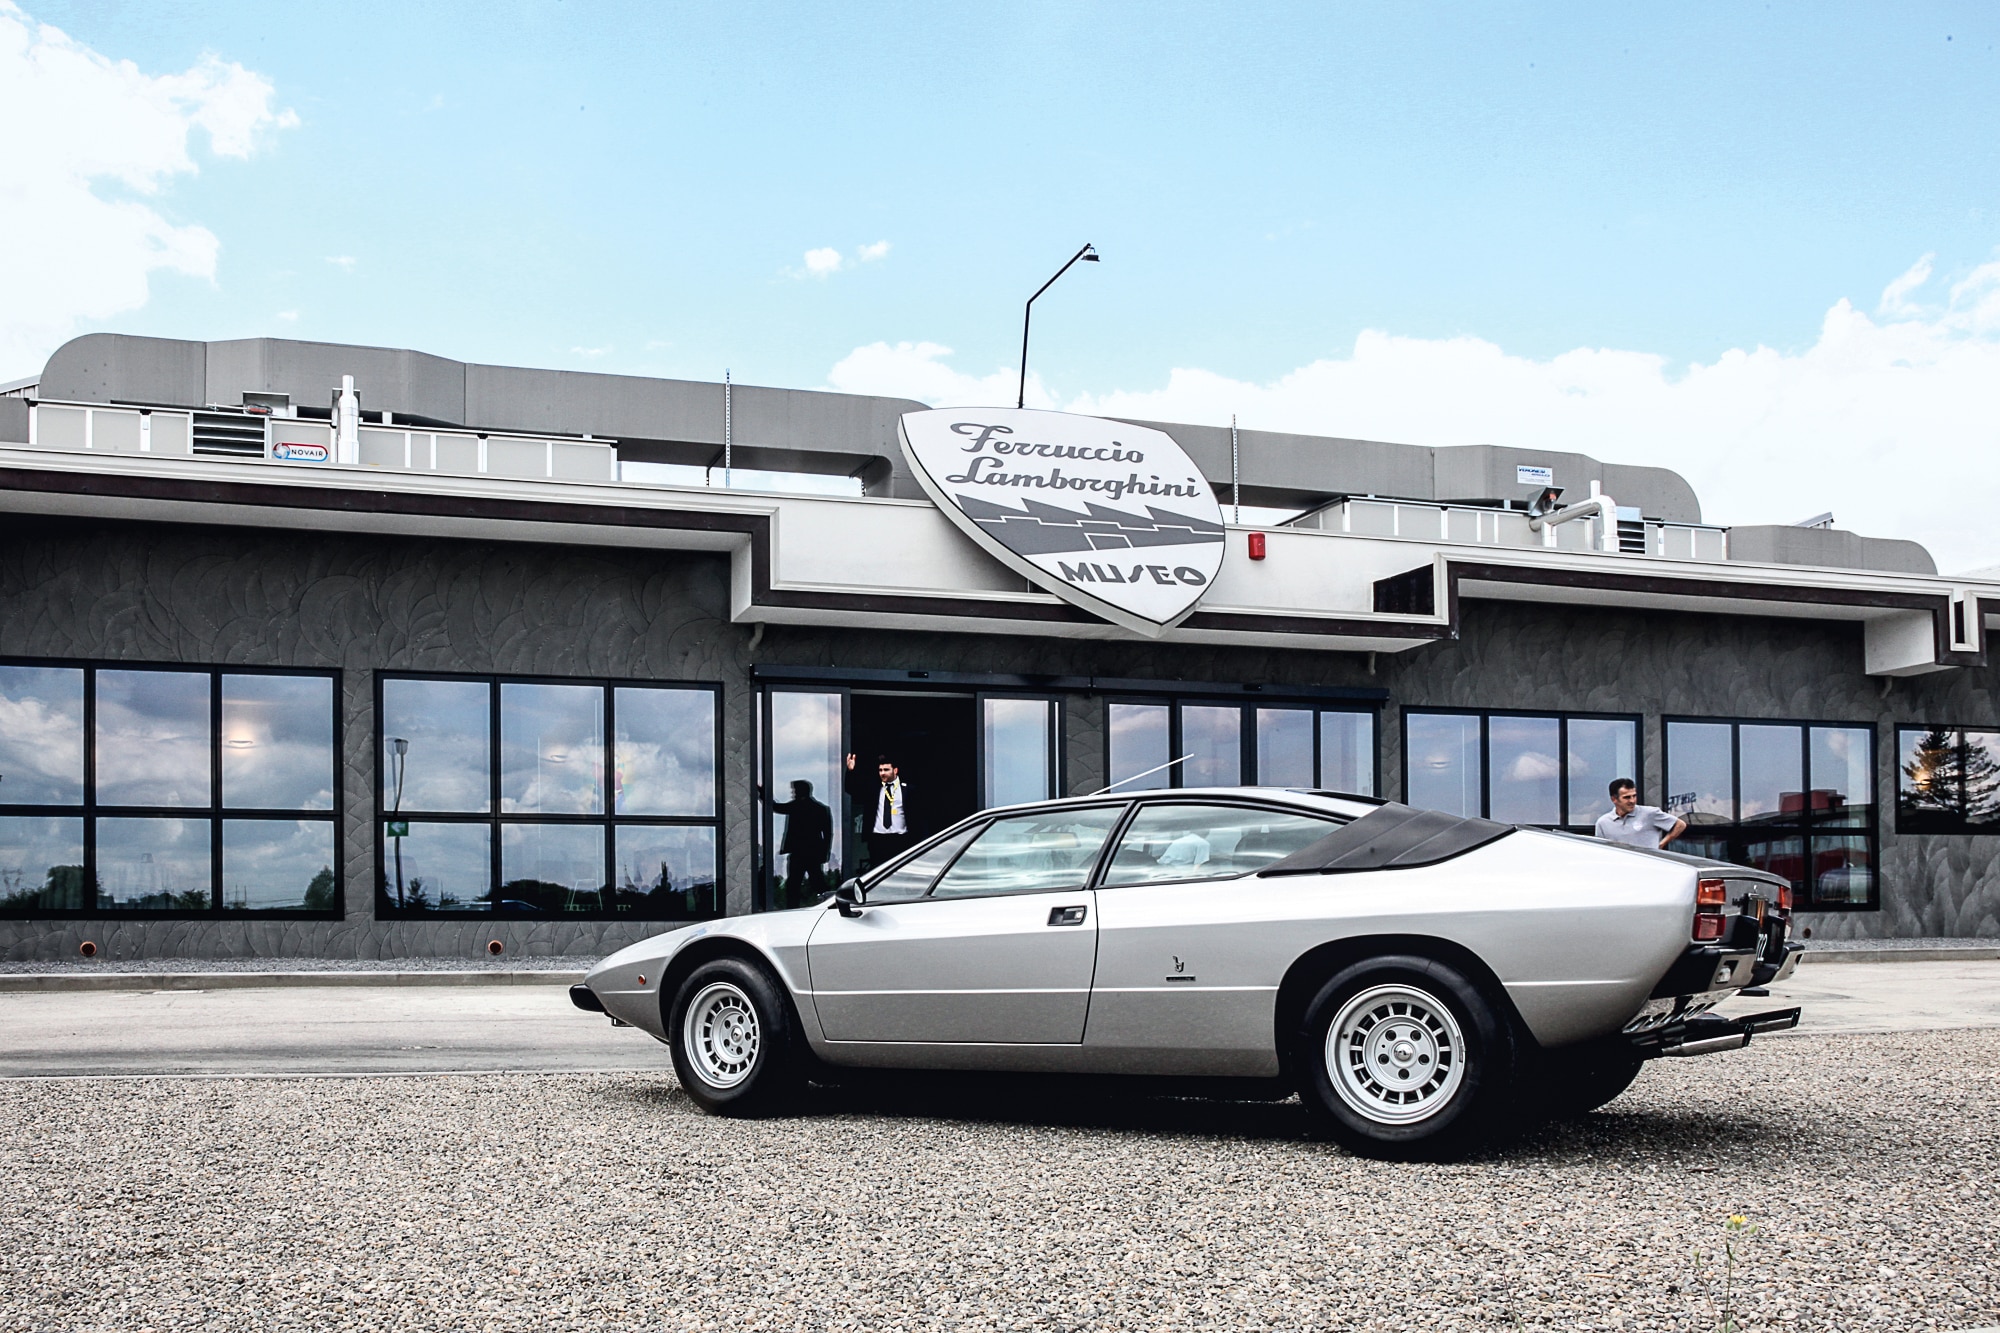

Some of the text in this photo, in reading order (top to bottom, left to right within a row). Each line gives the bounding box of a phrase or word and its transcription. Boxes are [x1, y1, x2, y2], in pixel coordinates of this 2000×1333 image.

[291, 449, 323, 457] NOVAIR
[950, 422, 1144, 464] Ferruccio
[945, 456, 1201, 500] Lamborghini
[1057, 561, 1207, 586] MUSEO
